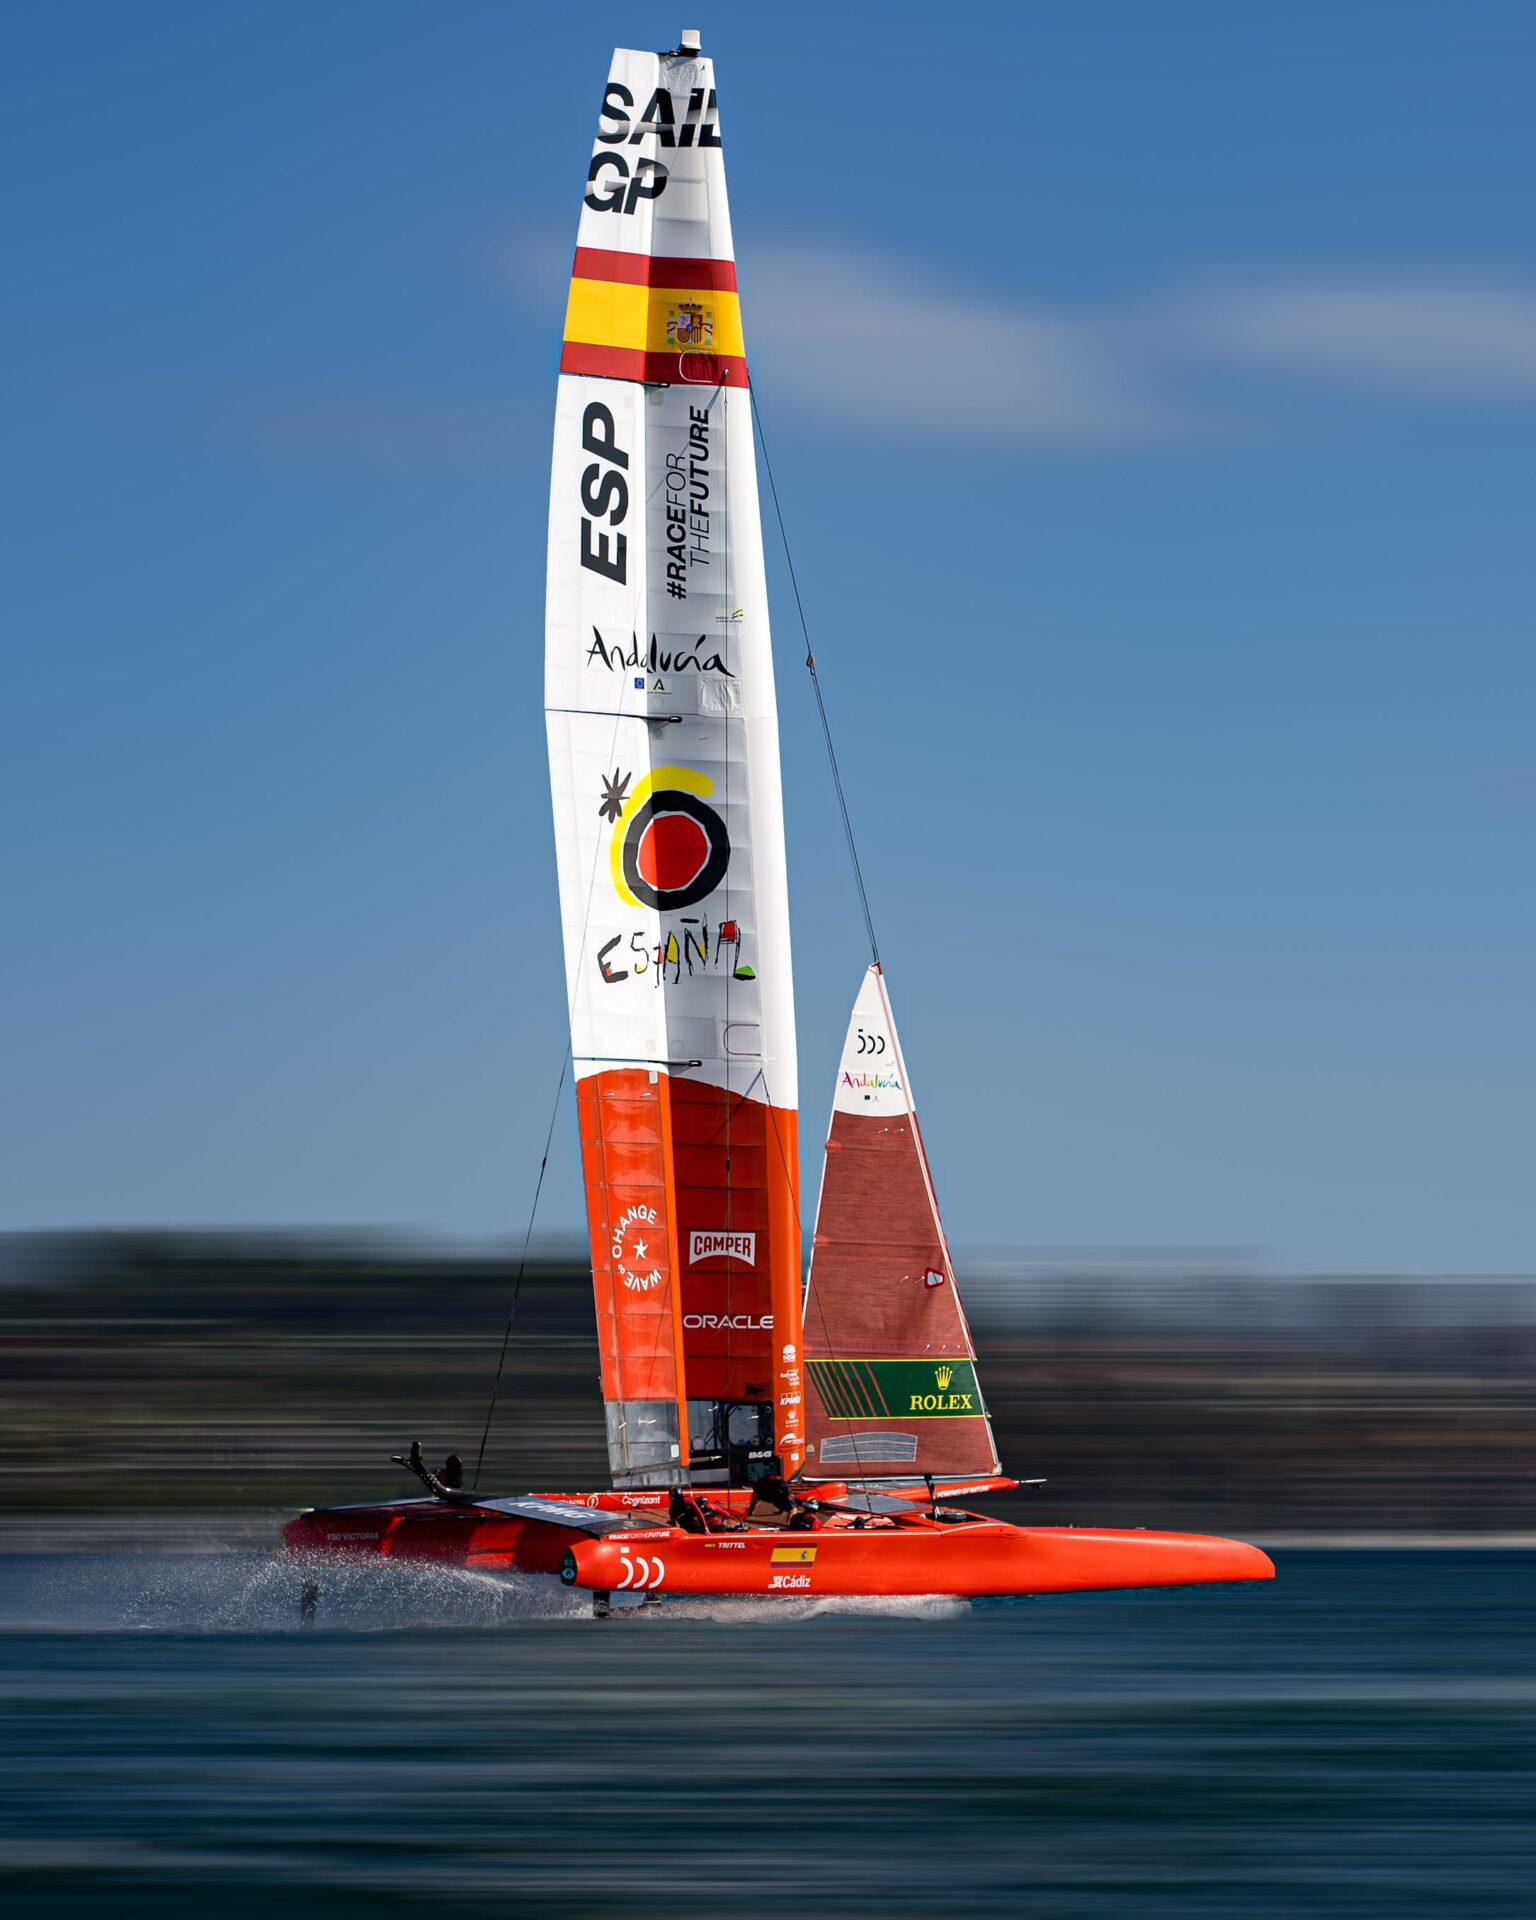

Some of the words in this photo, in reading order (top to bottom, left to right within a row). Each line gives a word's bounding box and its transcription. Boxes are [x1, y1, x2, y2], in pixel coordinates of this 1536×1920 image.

[597, 82, 722, 147] SAIL
[584, 151, 669, 215] GP
[581, 401, 629, 586] ESP
[690, 405, 709, 567] THEFUTURE
[666, 453, 687, 600] #RACEFOR
[586, 625, 736, 678] Andalucía
[597, 912, 756, 988] ESPAÑA
[841, 1071, 903, 1090] Andalucía
[694, 1235, 751, 1257] CAMPER
[624, 1269, 662, 1292] WAVE
[683, 1315, 774, 1329] ORACLE
[910, 1394, 972, 1410] ROLEX
[748, 1451, 772, 1459] B&G
[622, 1496, 661, 1506] Cognizant
[782, 1575, 811, 1588] Cádiz
